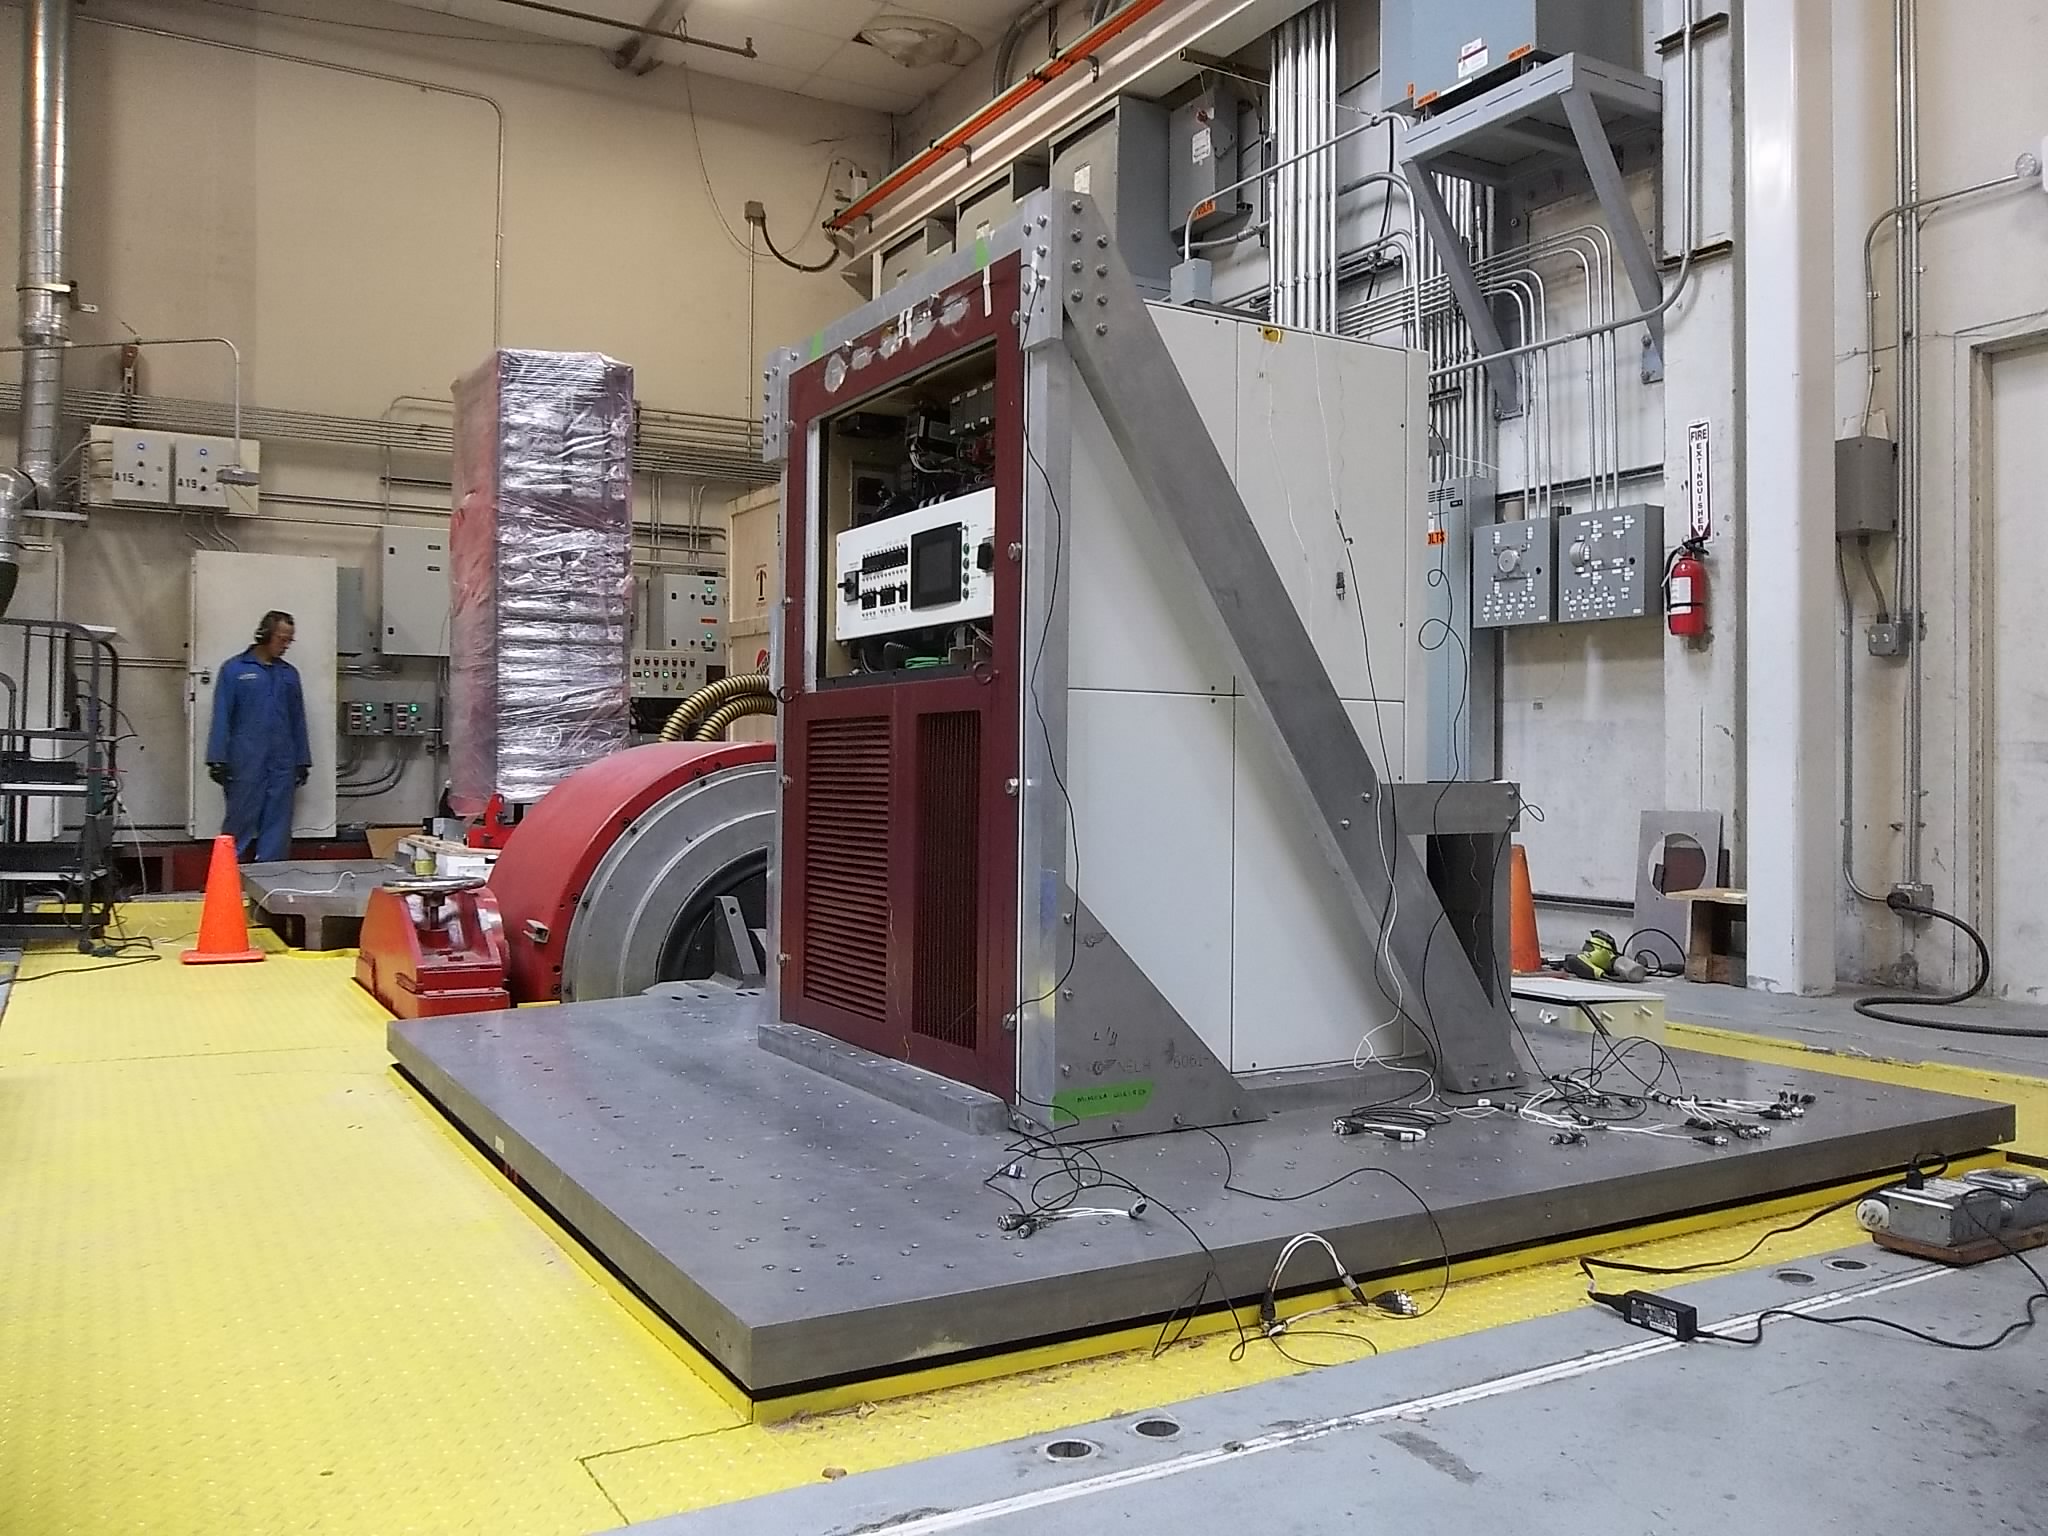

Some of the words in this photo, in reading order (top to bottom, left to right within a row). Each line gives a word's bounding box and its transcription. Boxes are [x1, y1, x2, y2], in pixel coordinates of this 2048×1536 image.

[1691, 429, 1707, 441] FIRE
[114, 472, 135, 483] A15
[177, 478, 198, 489] A19
[1696, 442, 1704, 531] EXTINGUISHER
